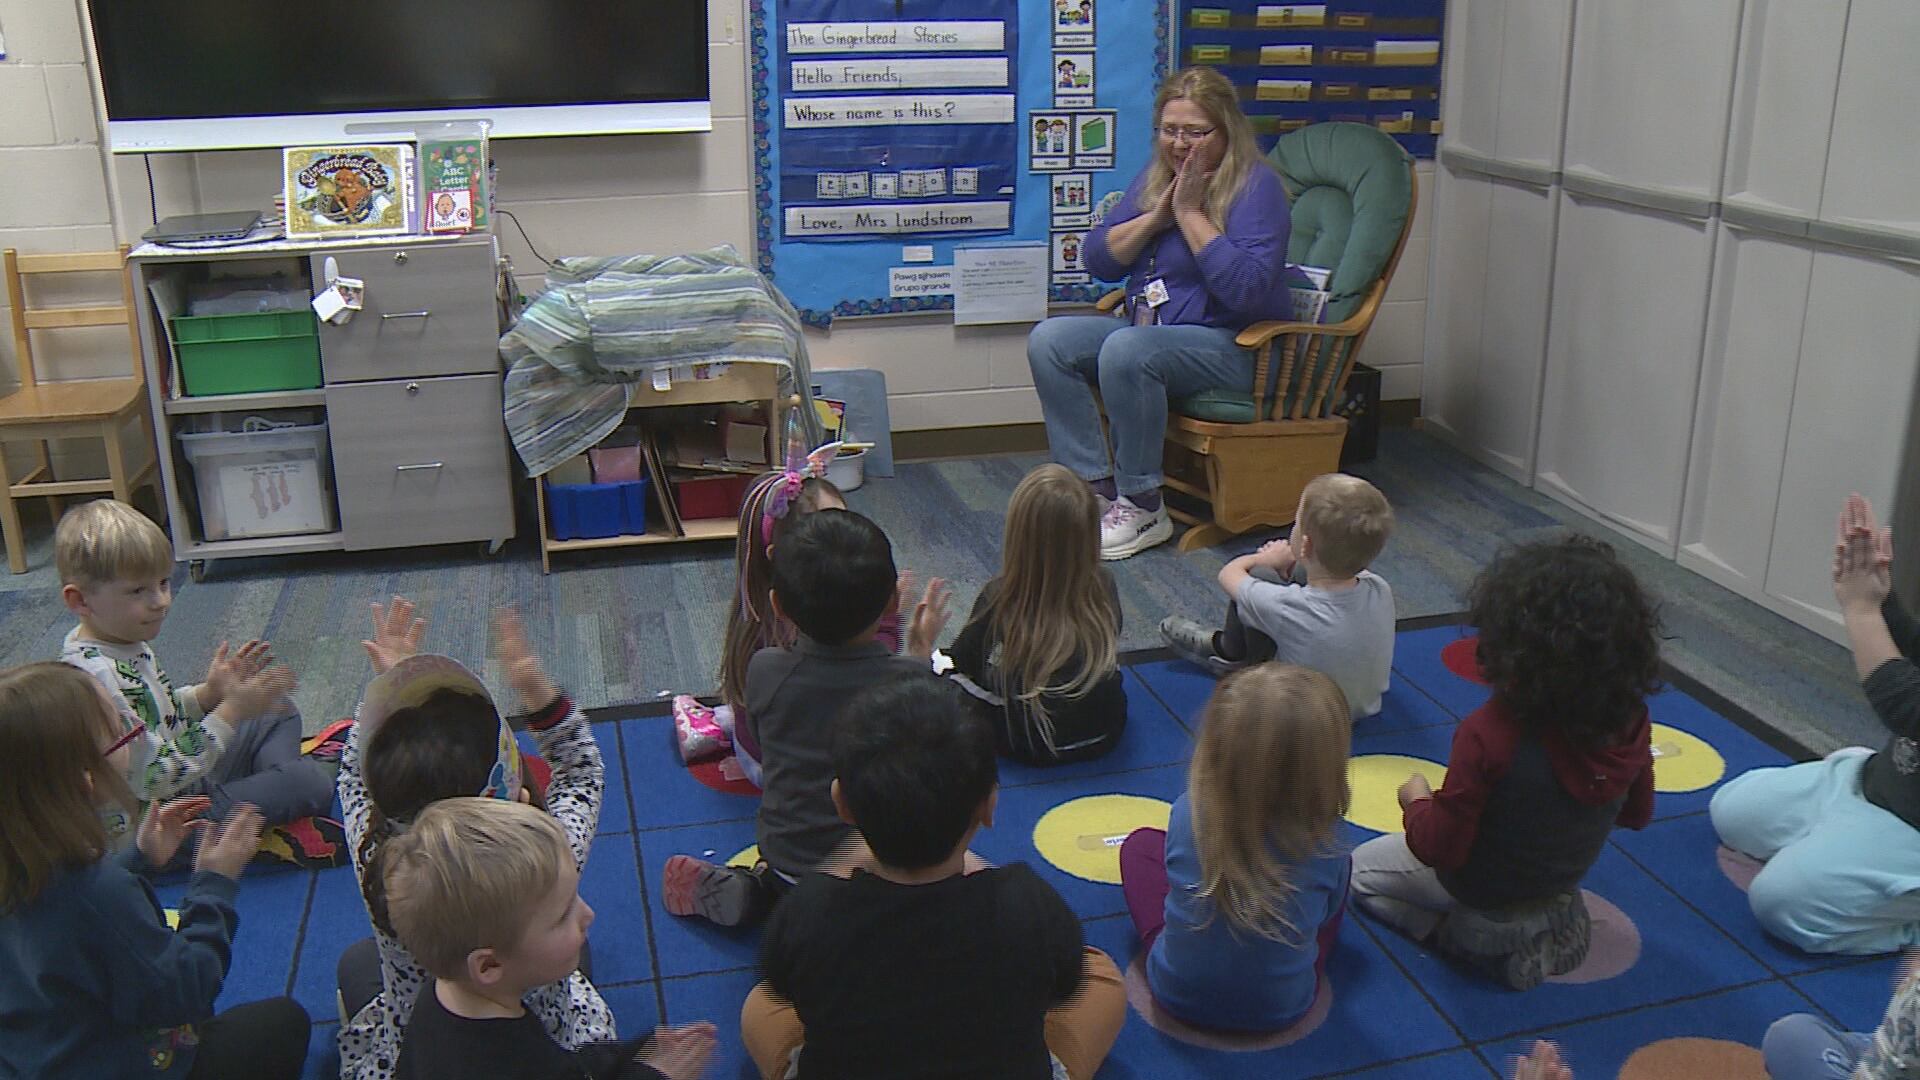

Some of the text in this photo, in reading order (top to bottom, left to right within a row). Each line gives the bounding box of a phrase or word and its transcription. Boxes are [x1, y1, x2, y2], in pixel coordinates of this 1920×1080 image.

[792, 25, 958, 48] The Gingerbread Stories
[795, 67, 833, 84] Hello
[794, 102, 956, 122] Whose name is this?
[442, 166, 464, 176] ABC
[440, 177, 468, 186] Letter
[855, 213, 887, 228] Mrs
[896, 210, 973, 227] Lundstrom
[894, 284, 920, 293] Grupo
[921, 282, 951, 292] grande
